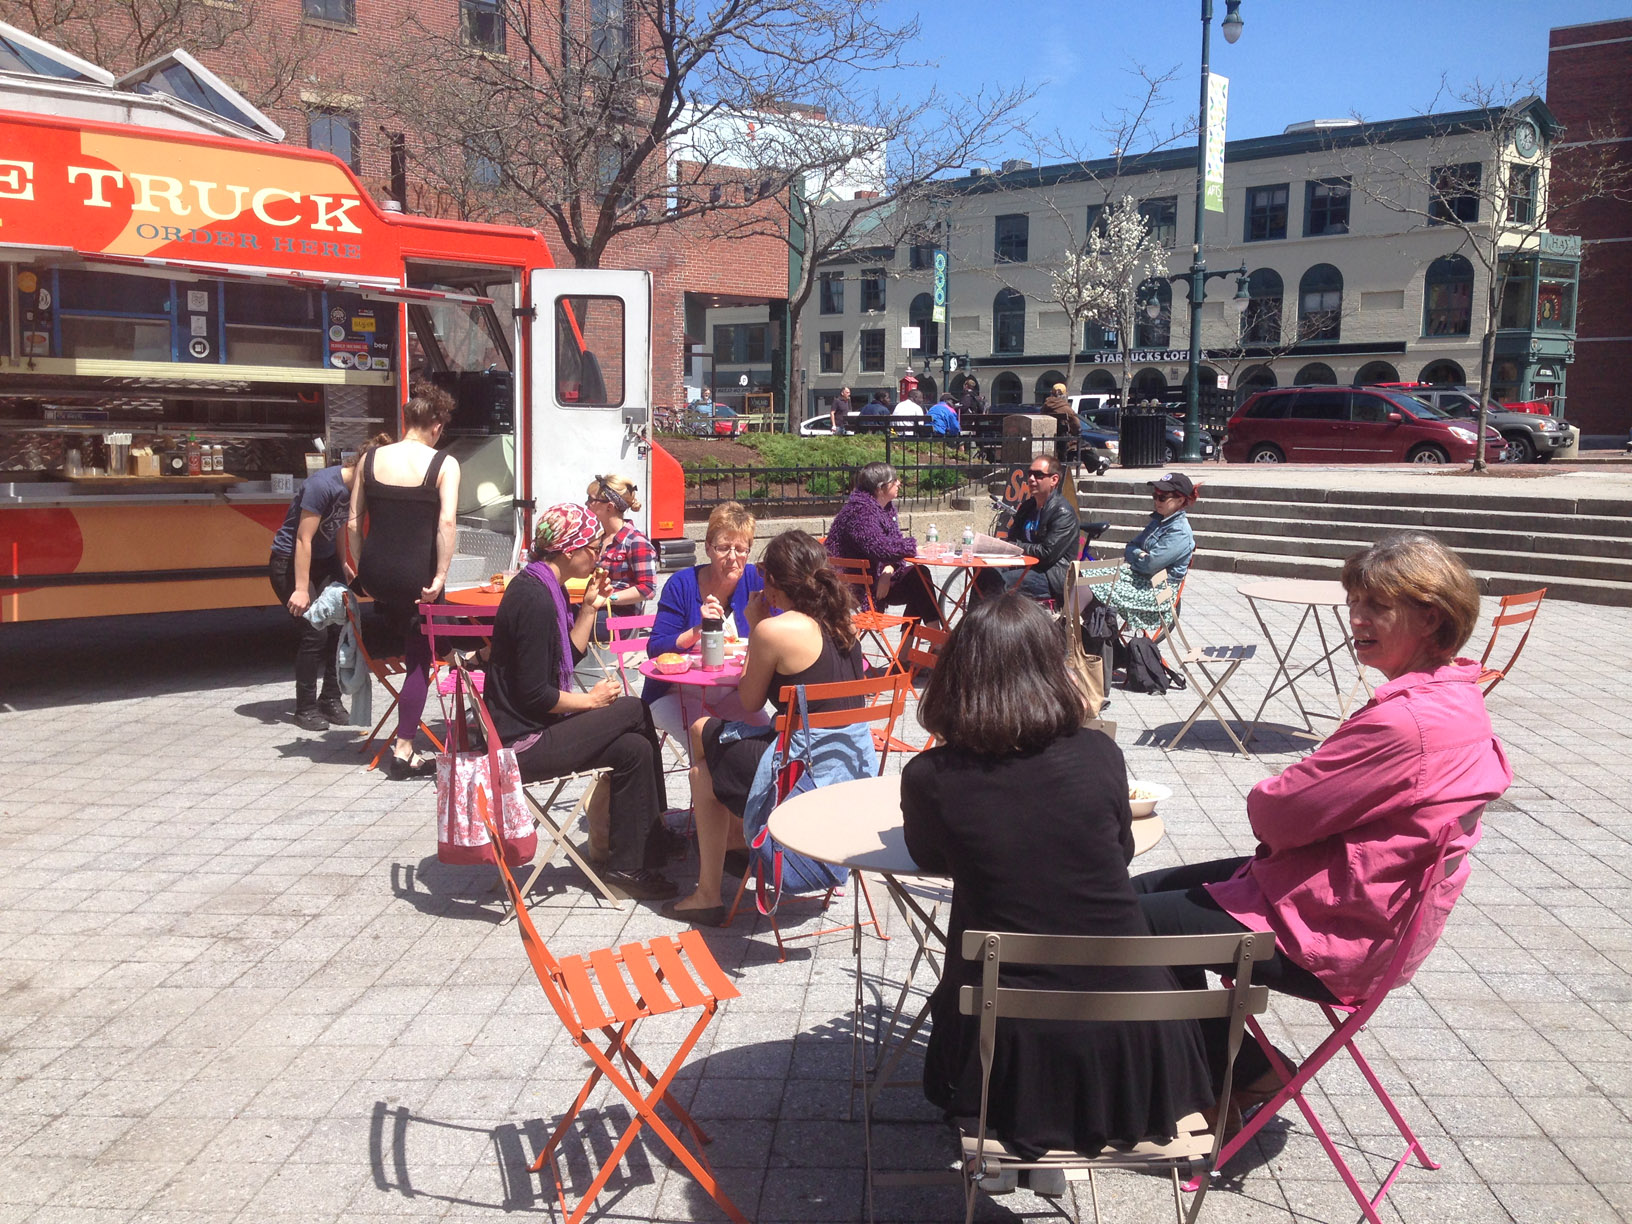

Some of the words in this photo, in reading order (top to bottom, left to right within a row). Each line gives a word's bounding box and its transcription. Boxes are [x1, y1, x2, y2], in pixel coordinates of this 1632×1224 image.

[67, 165, 363, 234] TRUCK
[136, 223, 262, 249] ORDER
[272, 236, 361, 259] HERE
[1094, 351, 1161, 363] STARUCKS
[1163, 350, 1208, 361] COFE
